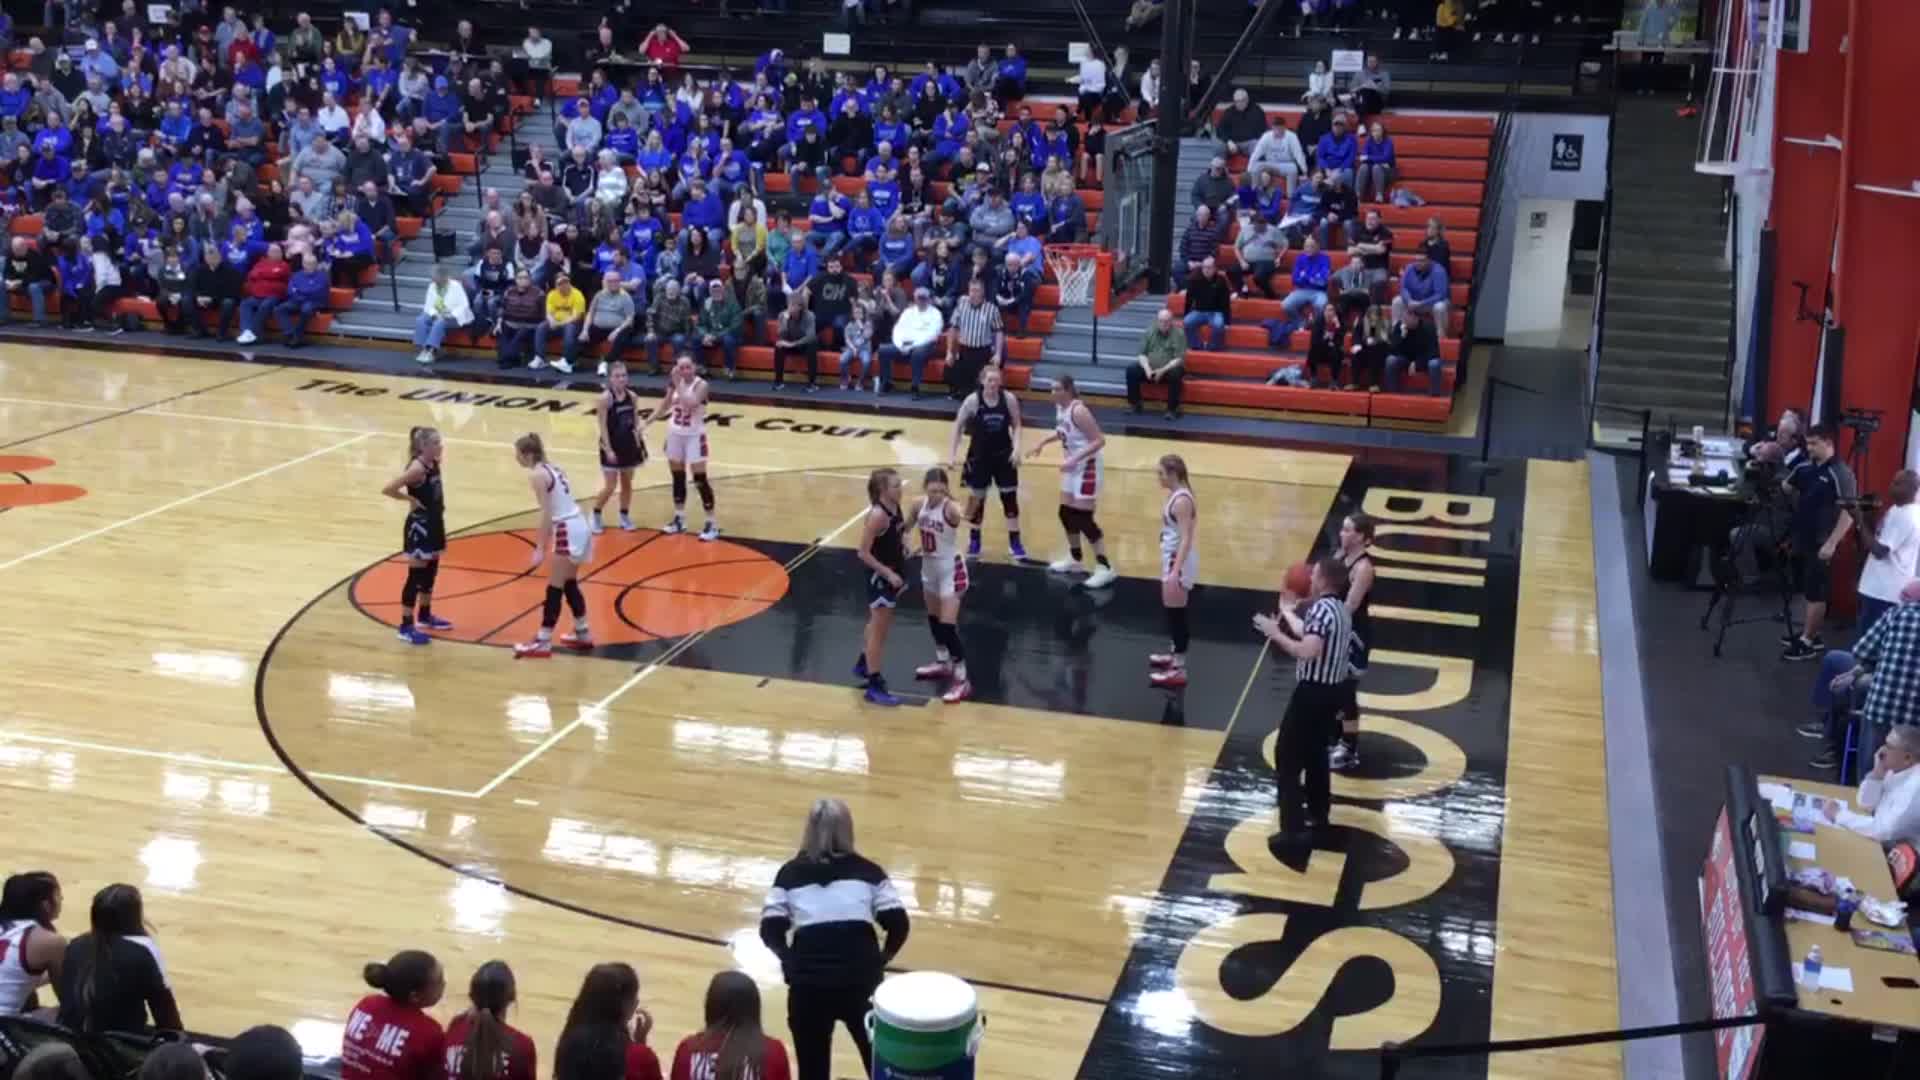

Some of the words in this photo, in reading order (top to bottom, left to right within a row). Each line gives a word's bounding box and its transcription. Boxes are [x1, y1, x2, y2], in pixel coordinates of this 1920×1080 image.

[297, 379, 389, 397] The
[399, 388, 579, 415] UNION
[754, 418, 904, 442] Court
[673, 407, 691, 427] 22
[376, 1023, 410, 1057] ME
